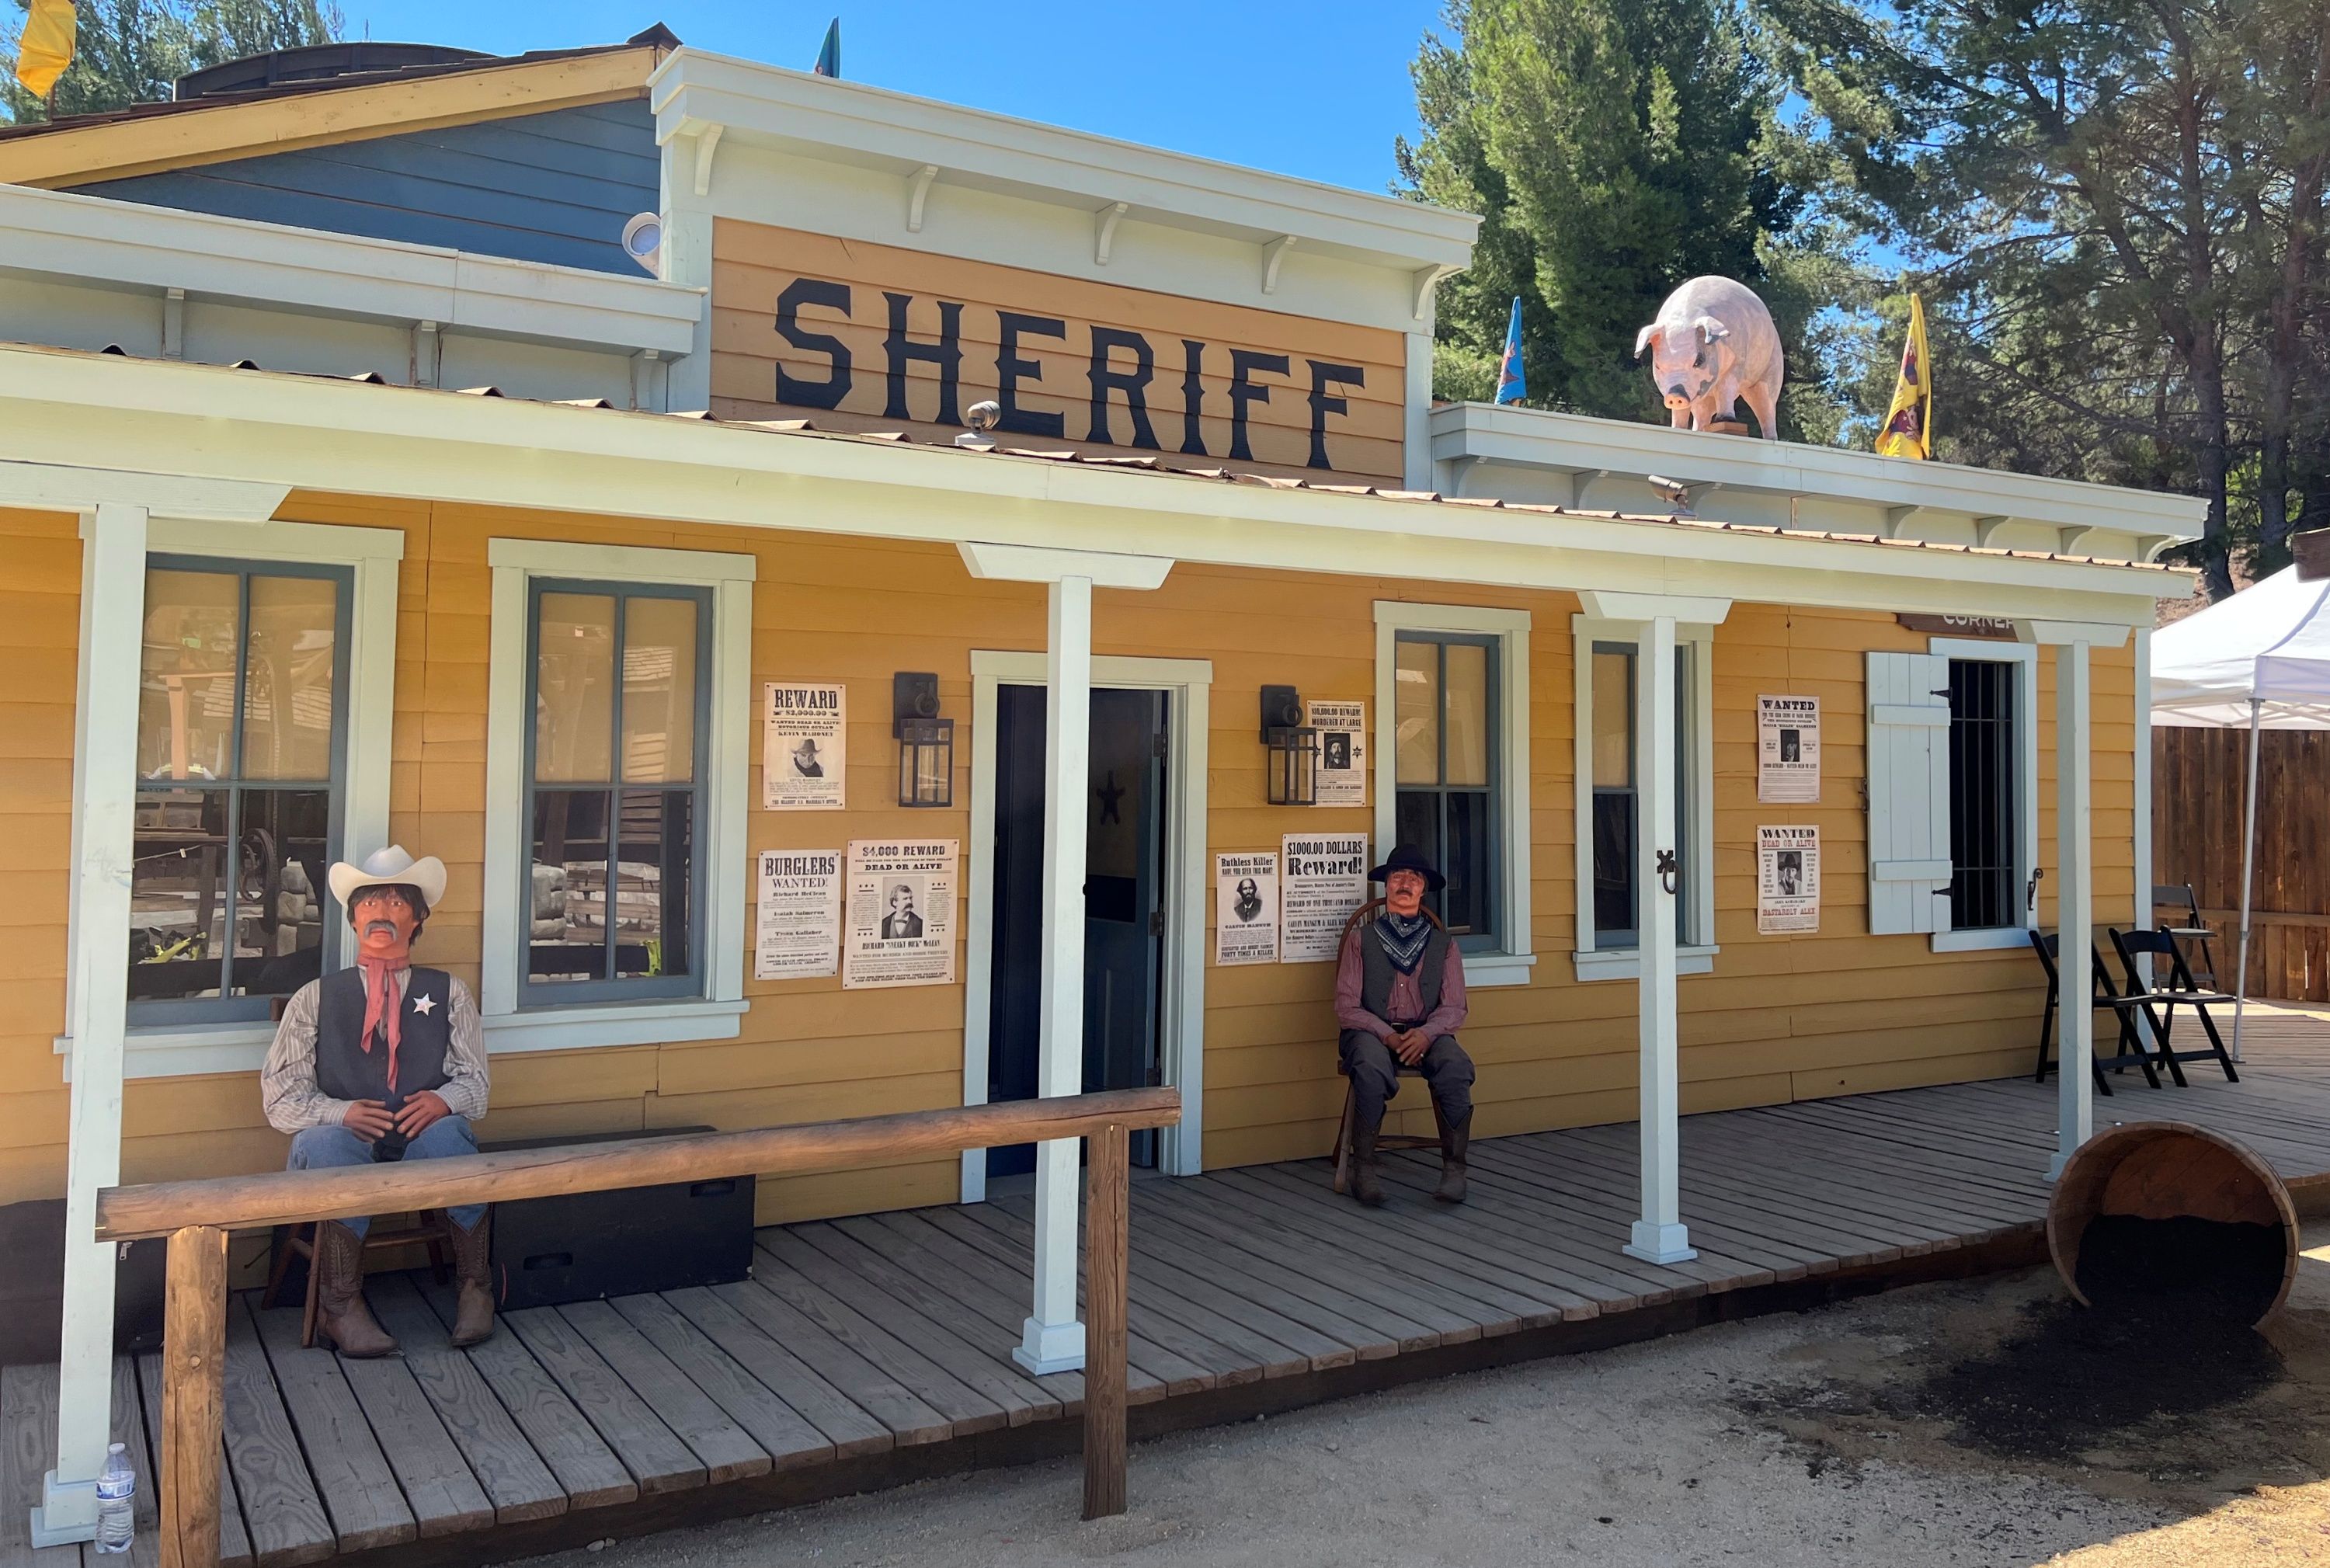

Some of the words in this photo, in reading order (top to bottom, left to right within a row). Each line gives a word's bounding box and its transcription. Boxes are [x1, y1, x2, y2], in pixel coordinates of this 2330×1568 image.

[775, 277, 1365, 471] SHERIFF
[774, 689, 837, 709] REWARD
[1762, 700, 1814, 710] WANTED
[1312, 718, 1338, 726] MURDERER
[1346, 718, 1361, 727] LARGE
[1761, 829, 1815, 839] WANTED
[904, 846, 945, 856] REWARD
[1288, 842, 1323, 856] $1000.00
[1327, 841, 1362, 854] DOLLARS
[765, 857, 835, 876] BURGLERS
[1221, 857, 1251, 867] Ruthless
[1254, 857, 1273, 866] Killer
[1288, 857, 1362, 876] Reward!
[773, 878, 828, 888] WANTED!
